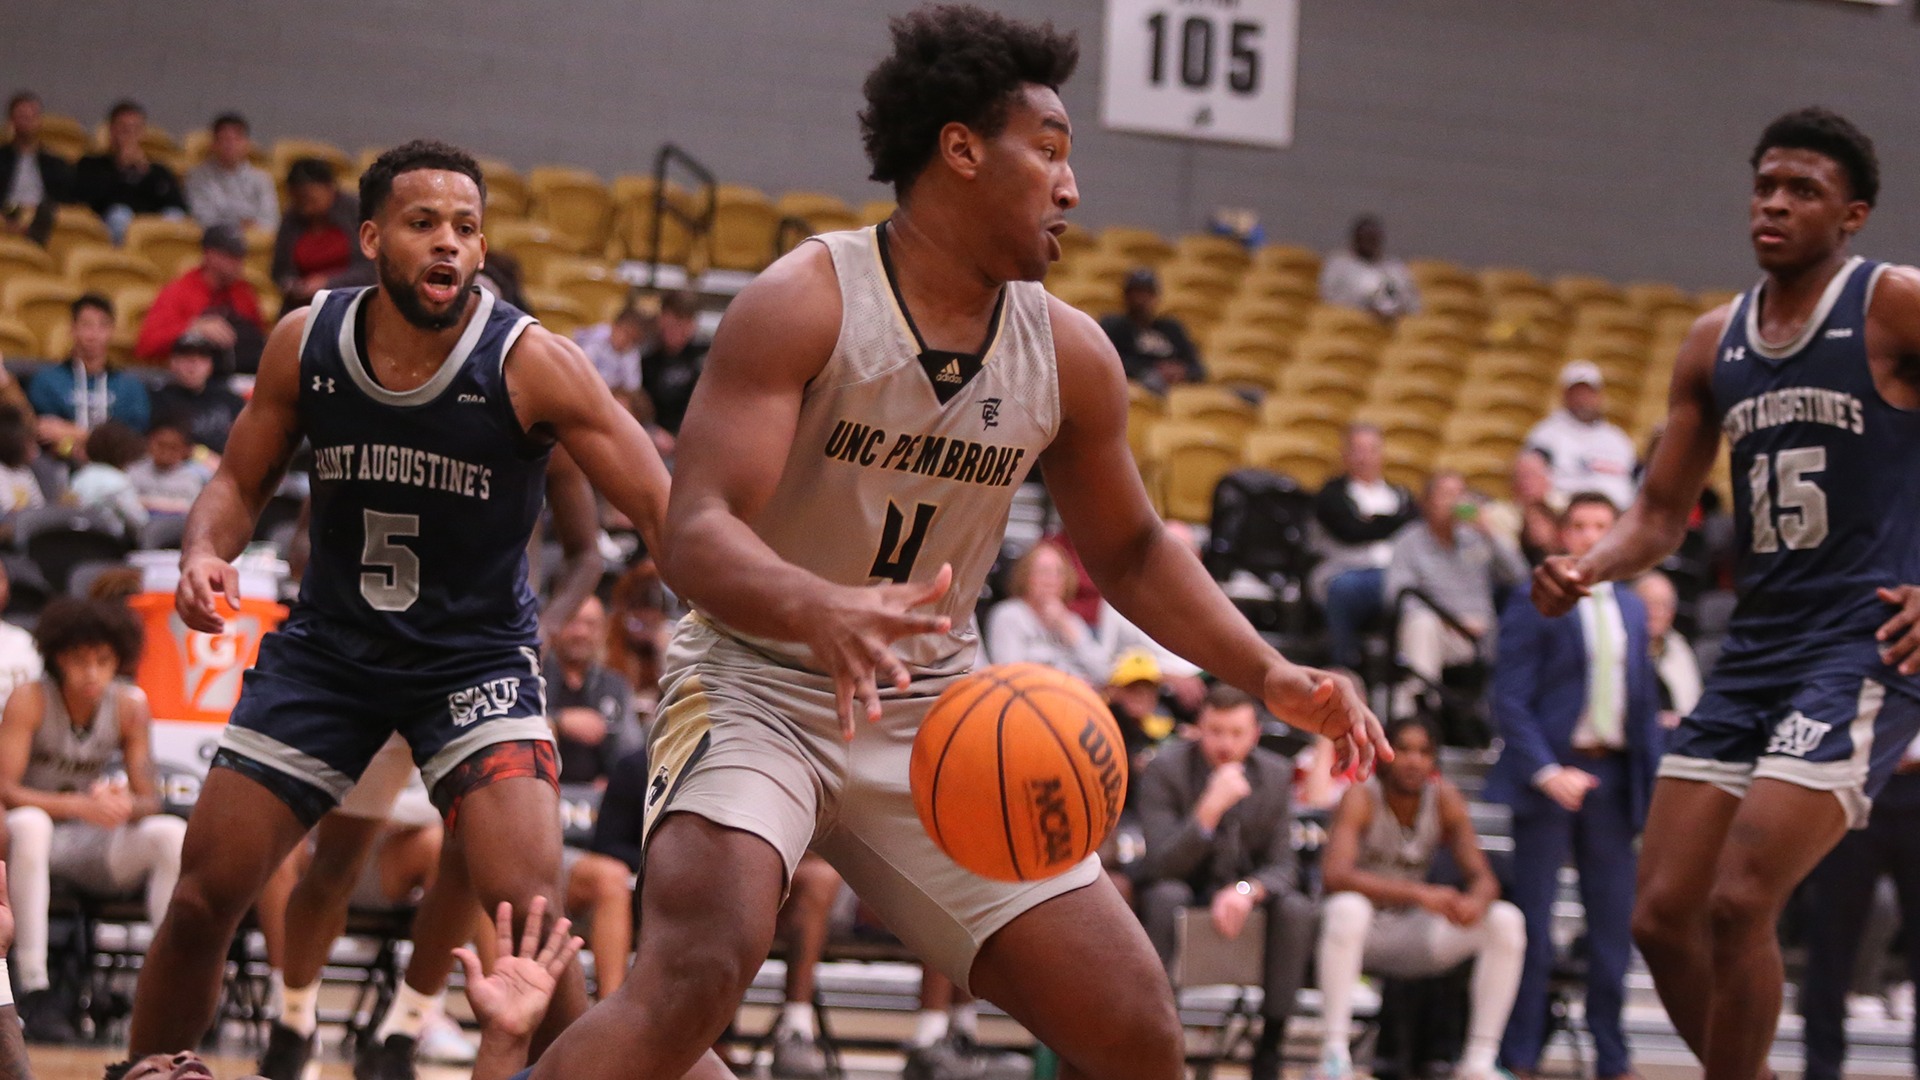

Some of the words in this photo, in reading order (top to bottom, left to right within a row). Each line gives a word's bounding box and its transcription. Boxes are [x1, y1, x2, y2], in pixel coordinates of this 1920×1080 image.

[1147, 12, 1261, 95] 105
[935, 373, 963, 385] adidas
[357, 443, 492, 501] AUGUSTINE'S
[823, 419, 887, 468] UNC
[879, 432, 1026, 488] PEMBROKE
[1748, 445, 1829, 555] 15
[359, 507, 420, 612] 5
[868, 497, 939, 585] 4
[195, 619, 238, 668] G
[447, 677, 521, 727] SAU
